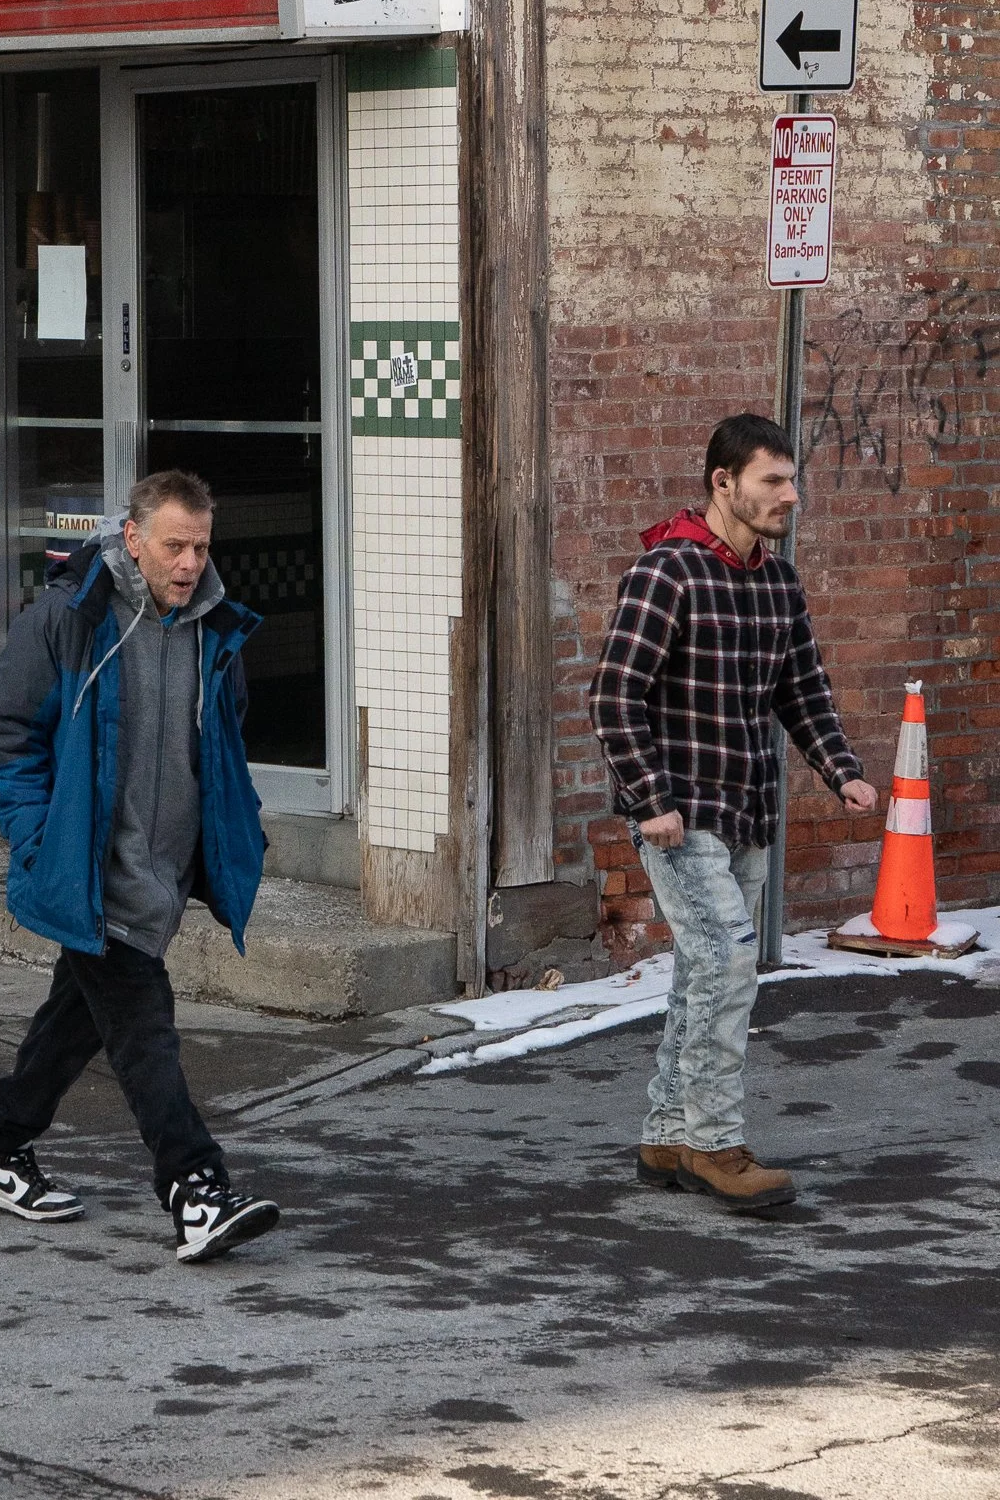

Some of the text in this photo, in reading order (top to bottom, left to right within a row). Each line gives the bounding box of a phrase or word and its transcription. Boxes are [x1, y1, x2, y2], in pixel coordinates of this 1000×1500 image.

[775, 128, 832, 159] NO PARKING
[780, 169, 823, 186] PERMIT
[776, 188, 827, 204] PARKING
[784, 206, 814, 222] ONLY
[787, 224, 807, 240] M-F
[774, 242, 824, 261] 8am-5pm
